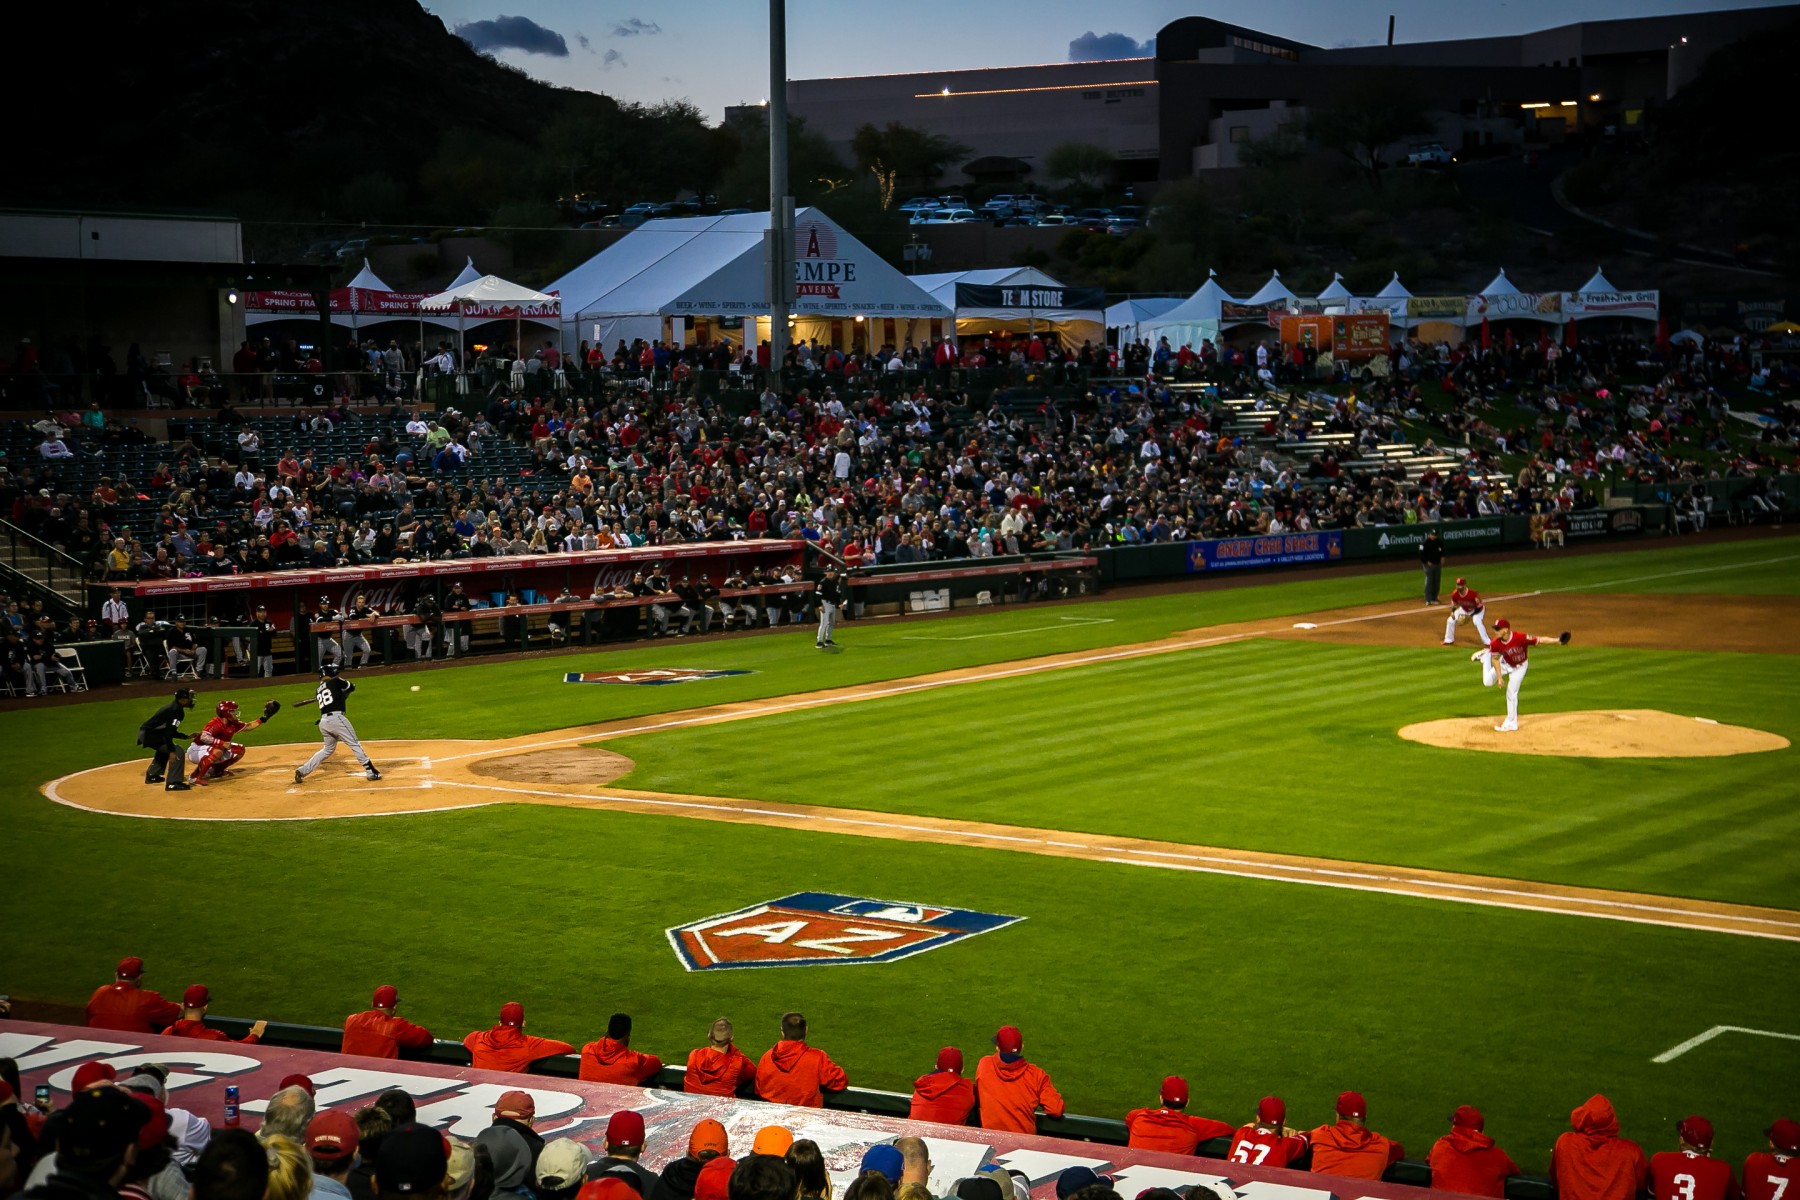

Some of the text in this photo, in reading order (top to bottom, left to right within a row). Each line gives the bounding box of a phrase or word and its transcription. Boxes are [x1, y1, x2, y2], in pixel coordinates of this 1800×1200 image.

[264, 298, 297, 308] SPRING
[1032, 290, 1063, 307] STORE
[1636, 292, 1655, 301] Grill
[379, 301, 409, 309] SPRING
[676, 301, 692, 309] BEER
[722, 301, 747, 309] SPIRITS
[1216, 533, 1320, 559] ANGRY CRAB SHACK
[1390, 533, 1425, 545] GreenTree
[713, 920, 906, 954] AZ
[1230, 1139, 1271, 1166] 57
[1671, 1173, 1697, 1200] 3
